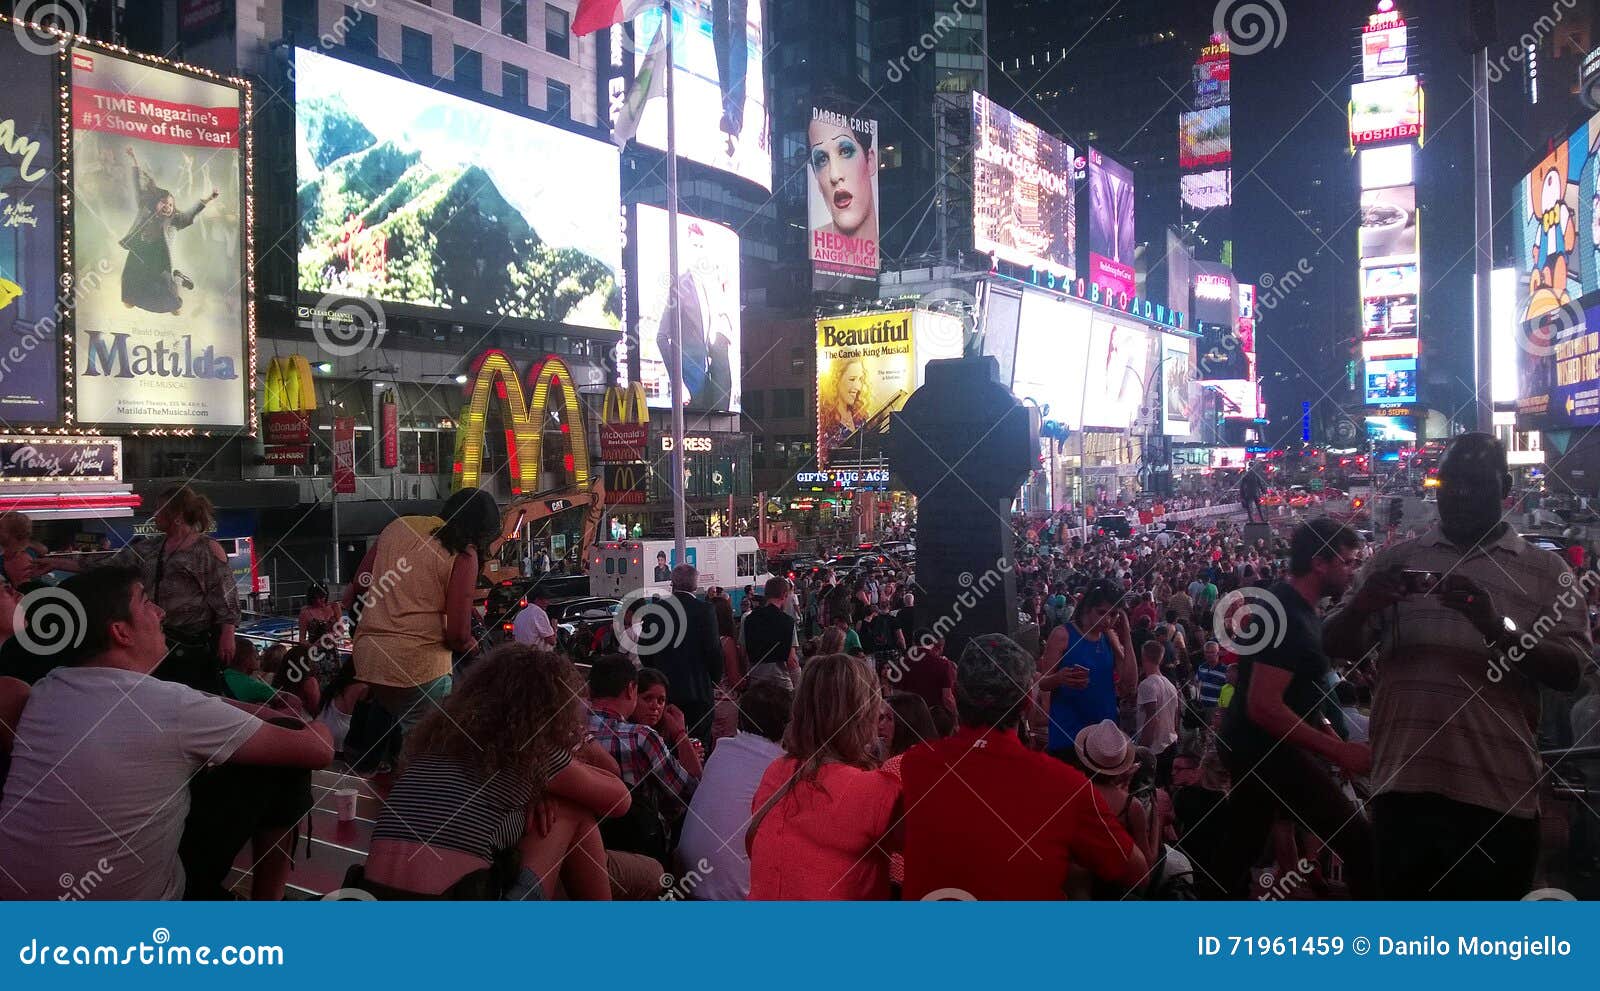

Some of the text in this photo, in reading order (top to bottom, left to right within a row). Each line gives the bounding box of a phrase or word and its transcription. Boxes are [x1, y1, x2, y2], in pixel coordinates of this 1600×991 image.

[1364, 19, 1405, 33] TOSHIBA
[93, 95, 219, 126] TIME Magazine's
[82, 112, 231, 144] #1 Show of the Year!
[812, 106, 876, 135] DARREN CRISS
[1353, 124, 1418, 143] TOSHIBA
[1074, 171, 1085, 180] LG
[814, 230, 876, 255] HEDWIG
[815, 248, 876, 267] ANGRY INCH
[1090, 282, 1186, 330] BROADWAY
[823, 319, 909, 348] Beautiful
[81, 330, 239, 380] Matilda
[825, 344, 909, 359] The Carole King Musical
[117, 407, 209, 417] MatildaTheMusical.com
[602, 430, 646, 440] McDonald's
[661, 437, 713, 451] ERESS
[10, 446, 62, 477] Paris
[797, 472, 890, 482] GIFTS LUGAGE
[551, 501, 565, 512] CAT
